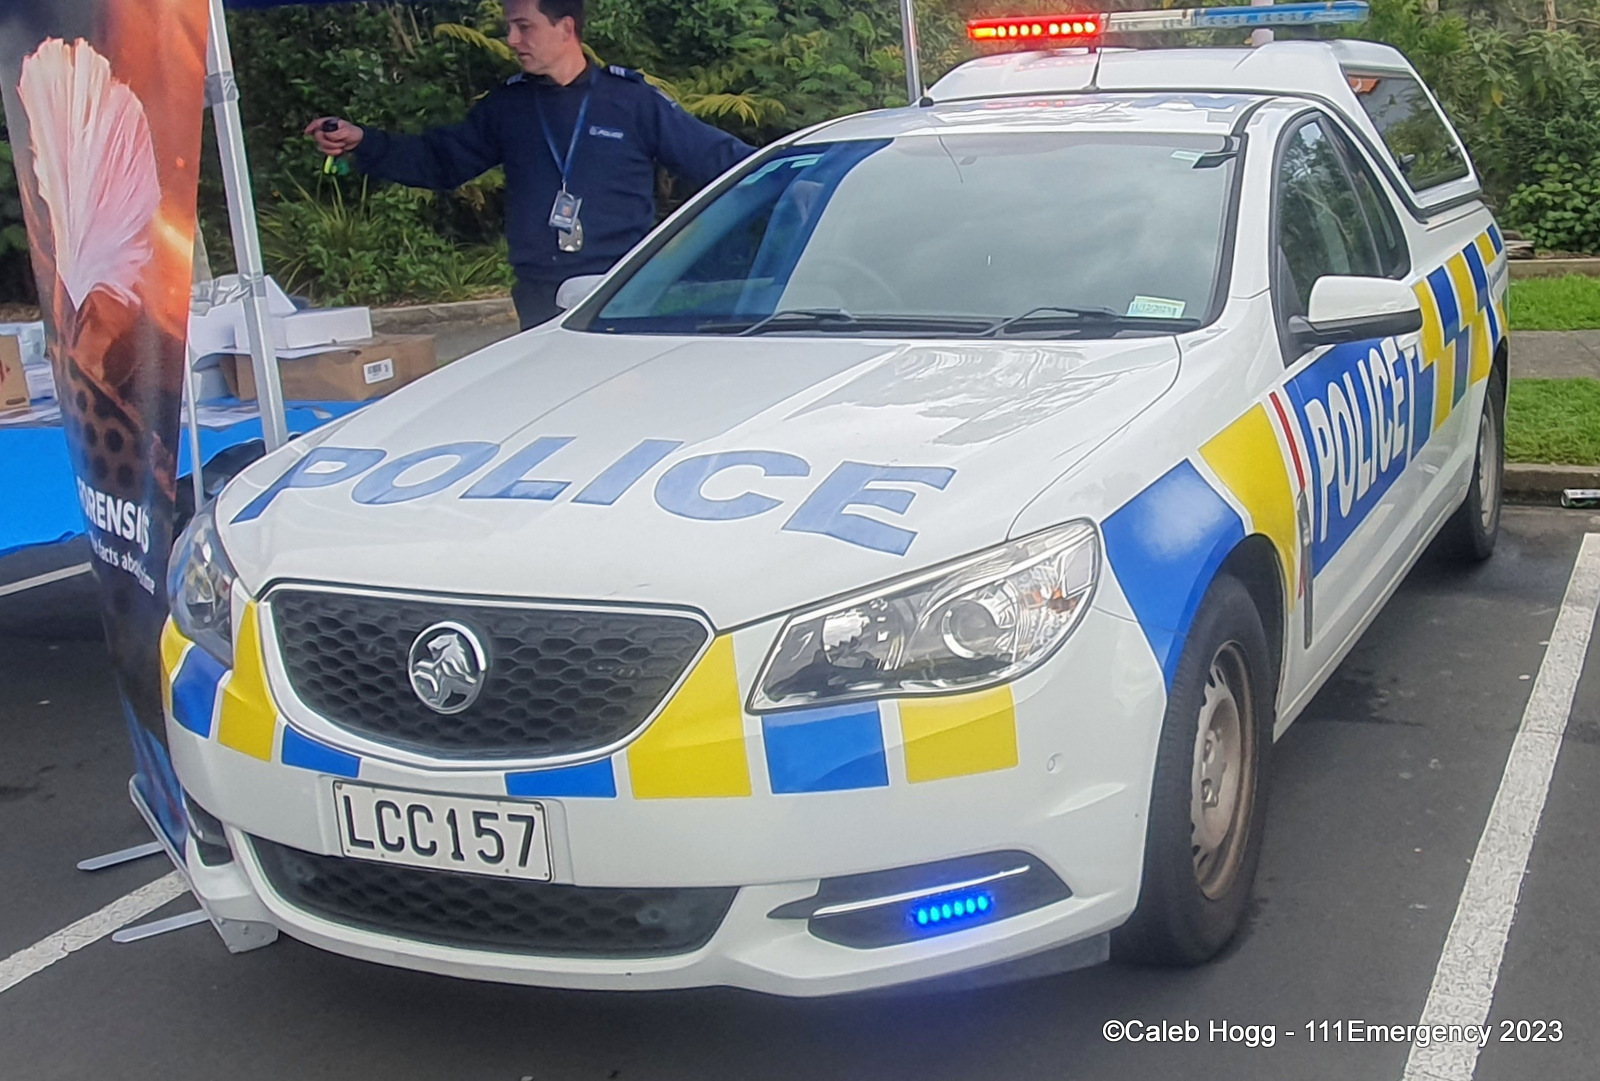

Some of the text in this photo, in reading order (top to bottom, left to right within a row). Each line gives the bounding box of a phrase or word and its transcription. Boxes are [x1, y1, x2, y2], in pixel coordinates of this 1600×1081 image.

[229, 436, 957, 556] POLICE
[1304, 337, 1406, 543] POLICE
[343, 795, 535, 867] LCC157
